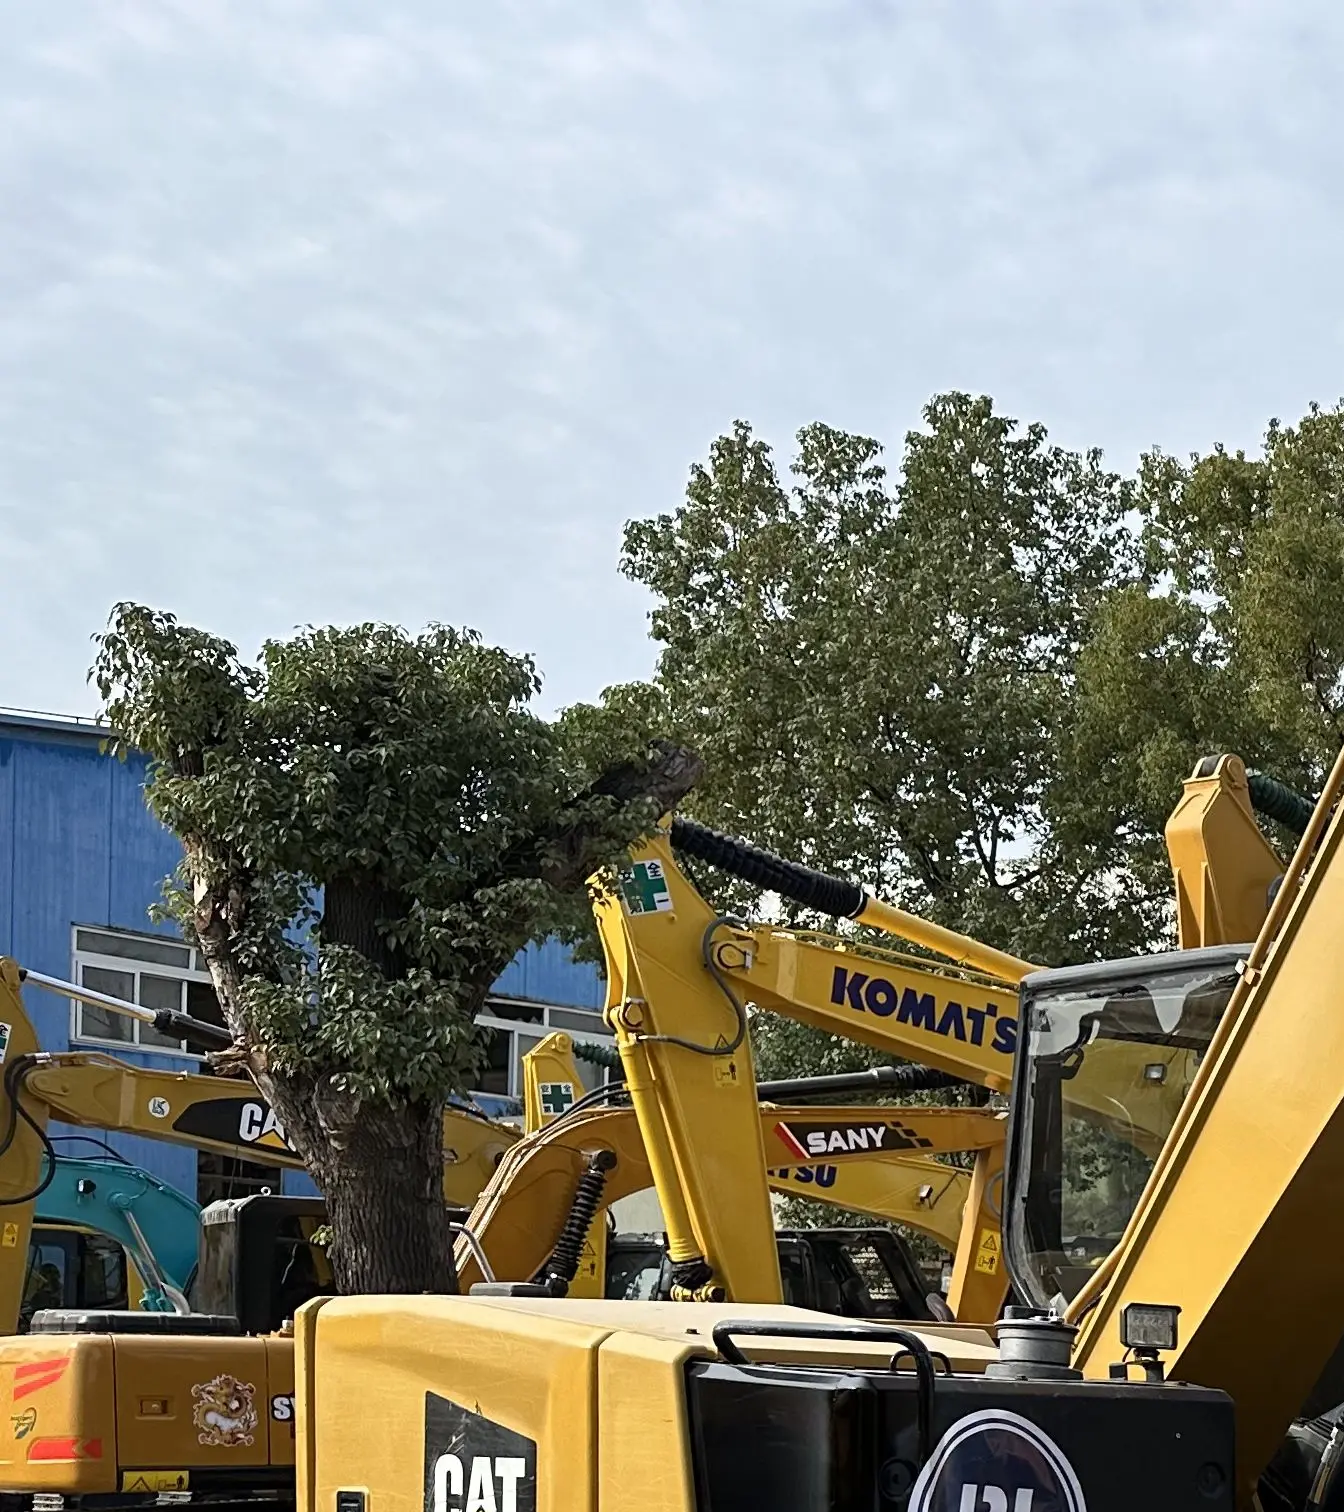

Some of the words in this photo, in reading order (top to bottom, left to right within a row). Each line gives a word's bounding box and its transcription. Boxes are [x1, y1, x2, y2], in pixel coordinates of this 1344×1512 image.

[239, 1102, 297, 1152] CA
[806, 1126, 886, 1154] SANY
[273, 1397, 296, 1420] S
